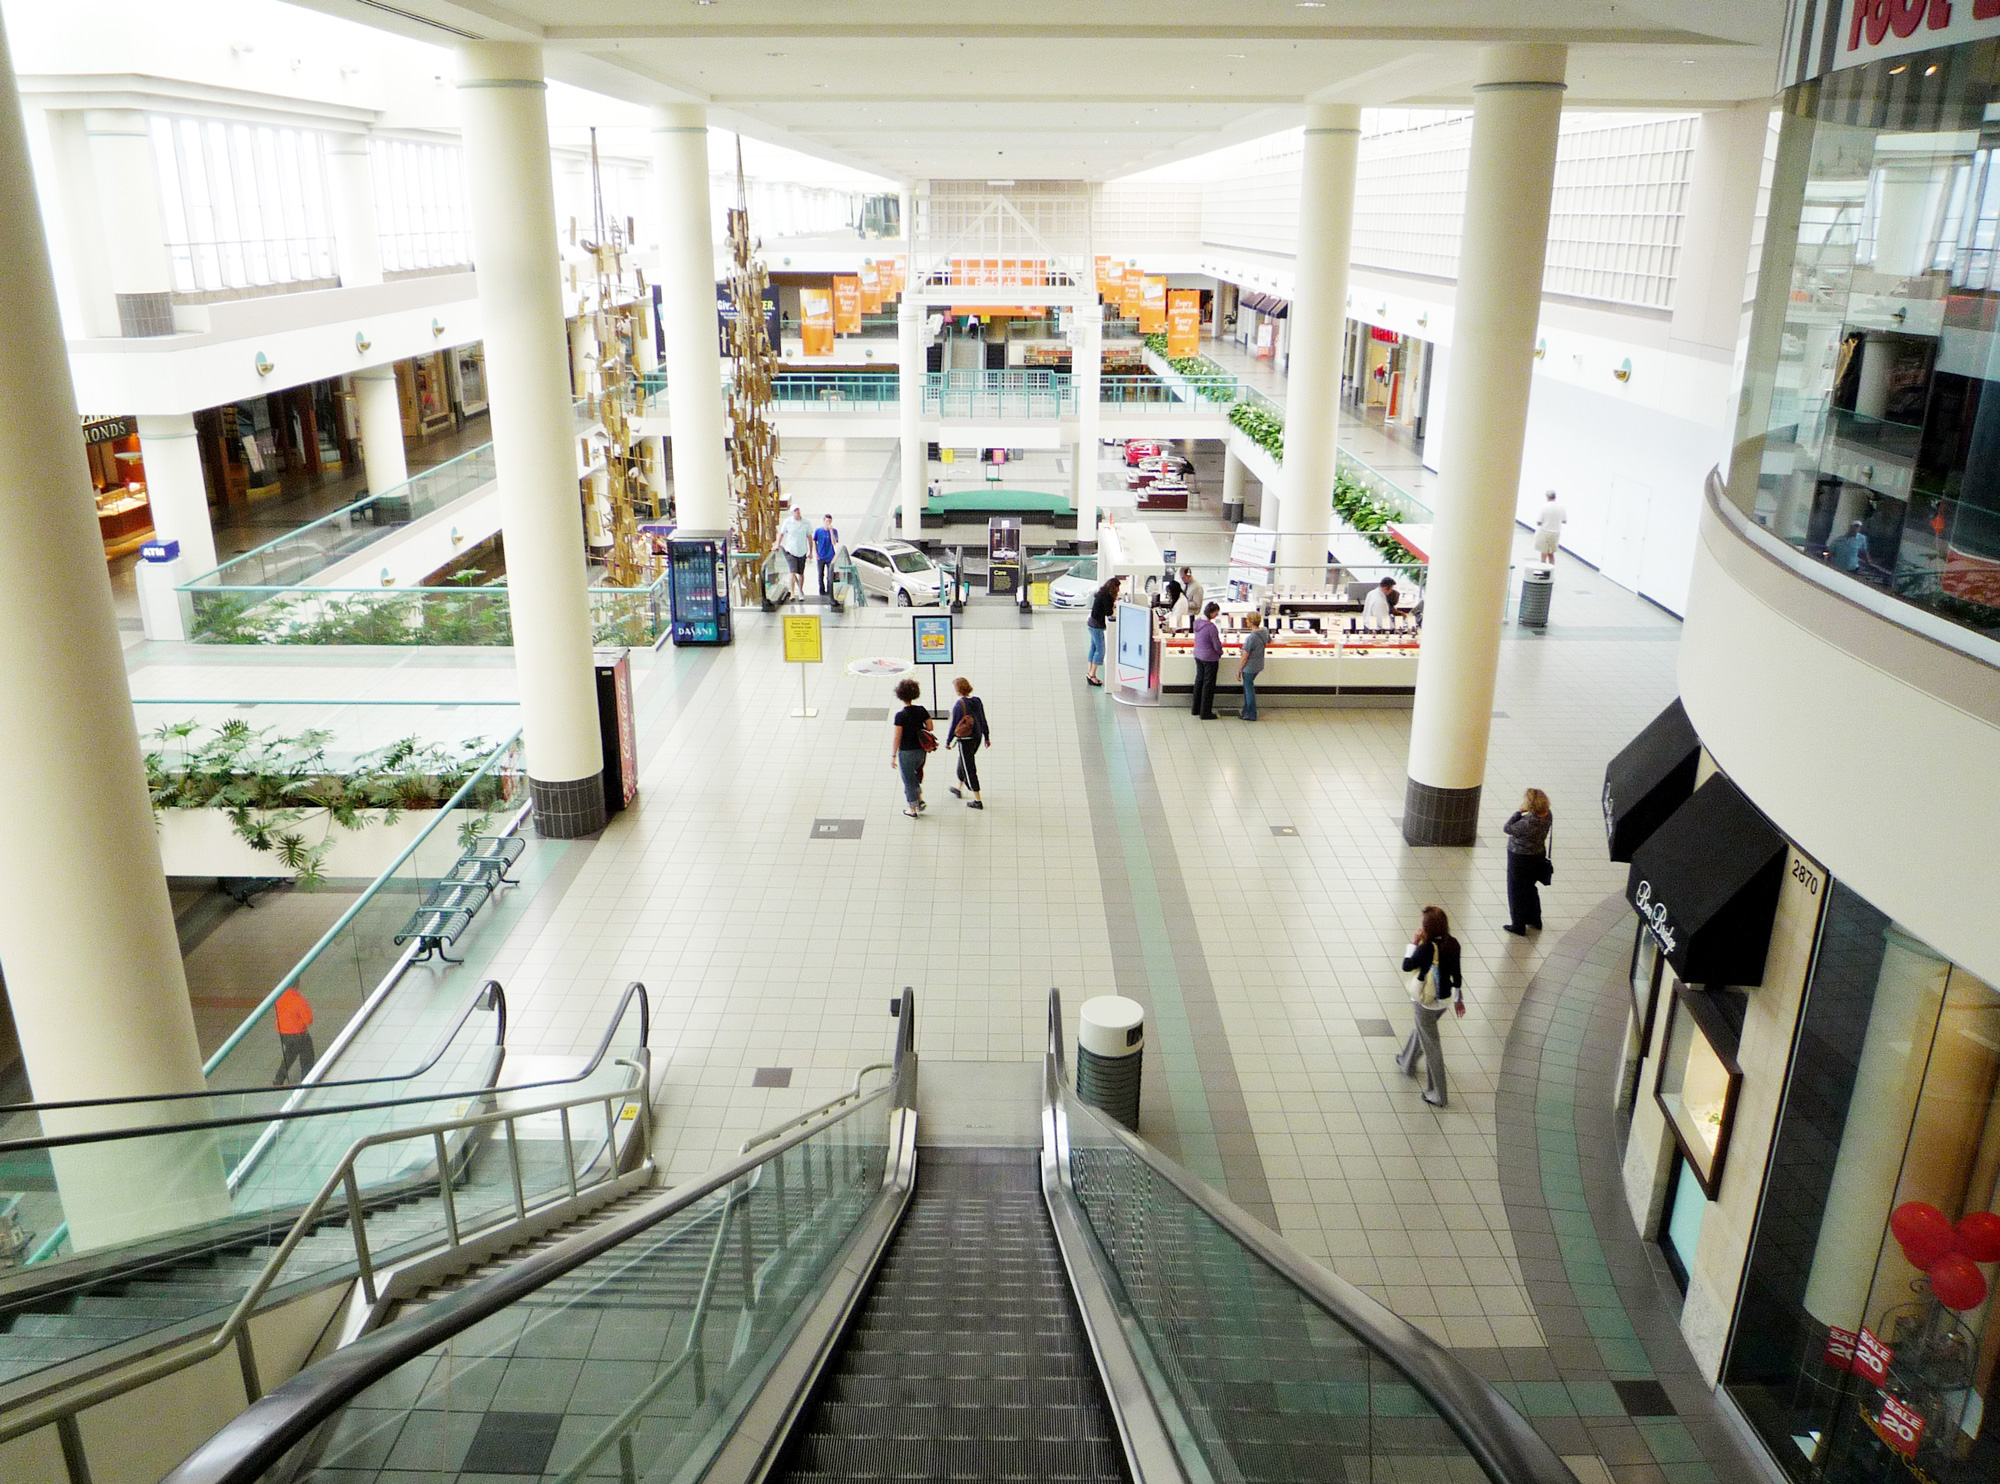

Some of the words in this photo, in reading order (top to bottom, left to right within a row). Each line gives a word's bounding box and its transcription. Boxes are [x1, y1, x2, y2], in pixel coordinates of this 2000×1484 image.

[1175, 299, 1194, 309] Every
[1174, 316, 1194, 326] Every
[143, 547, 165, 557] ATM
[678, 627, 713, 636] DASANI
[1792, 859, 1818, 895] 2870
[1636, 880, 1653, 919] Ben
[1651, 903, 1677, 955] Bridge
[1829, 1330, 1856, 1346] SAL
[1859, 1331, 1891, 1361] SALE
[1856, 1344, 1883, 1373] 20
[1881, 1413, 1914, 1442] 20
[1884, 1400, 1923, 1430] SALE
